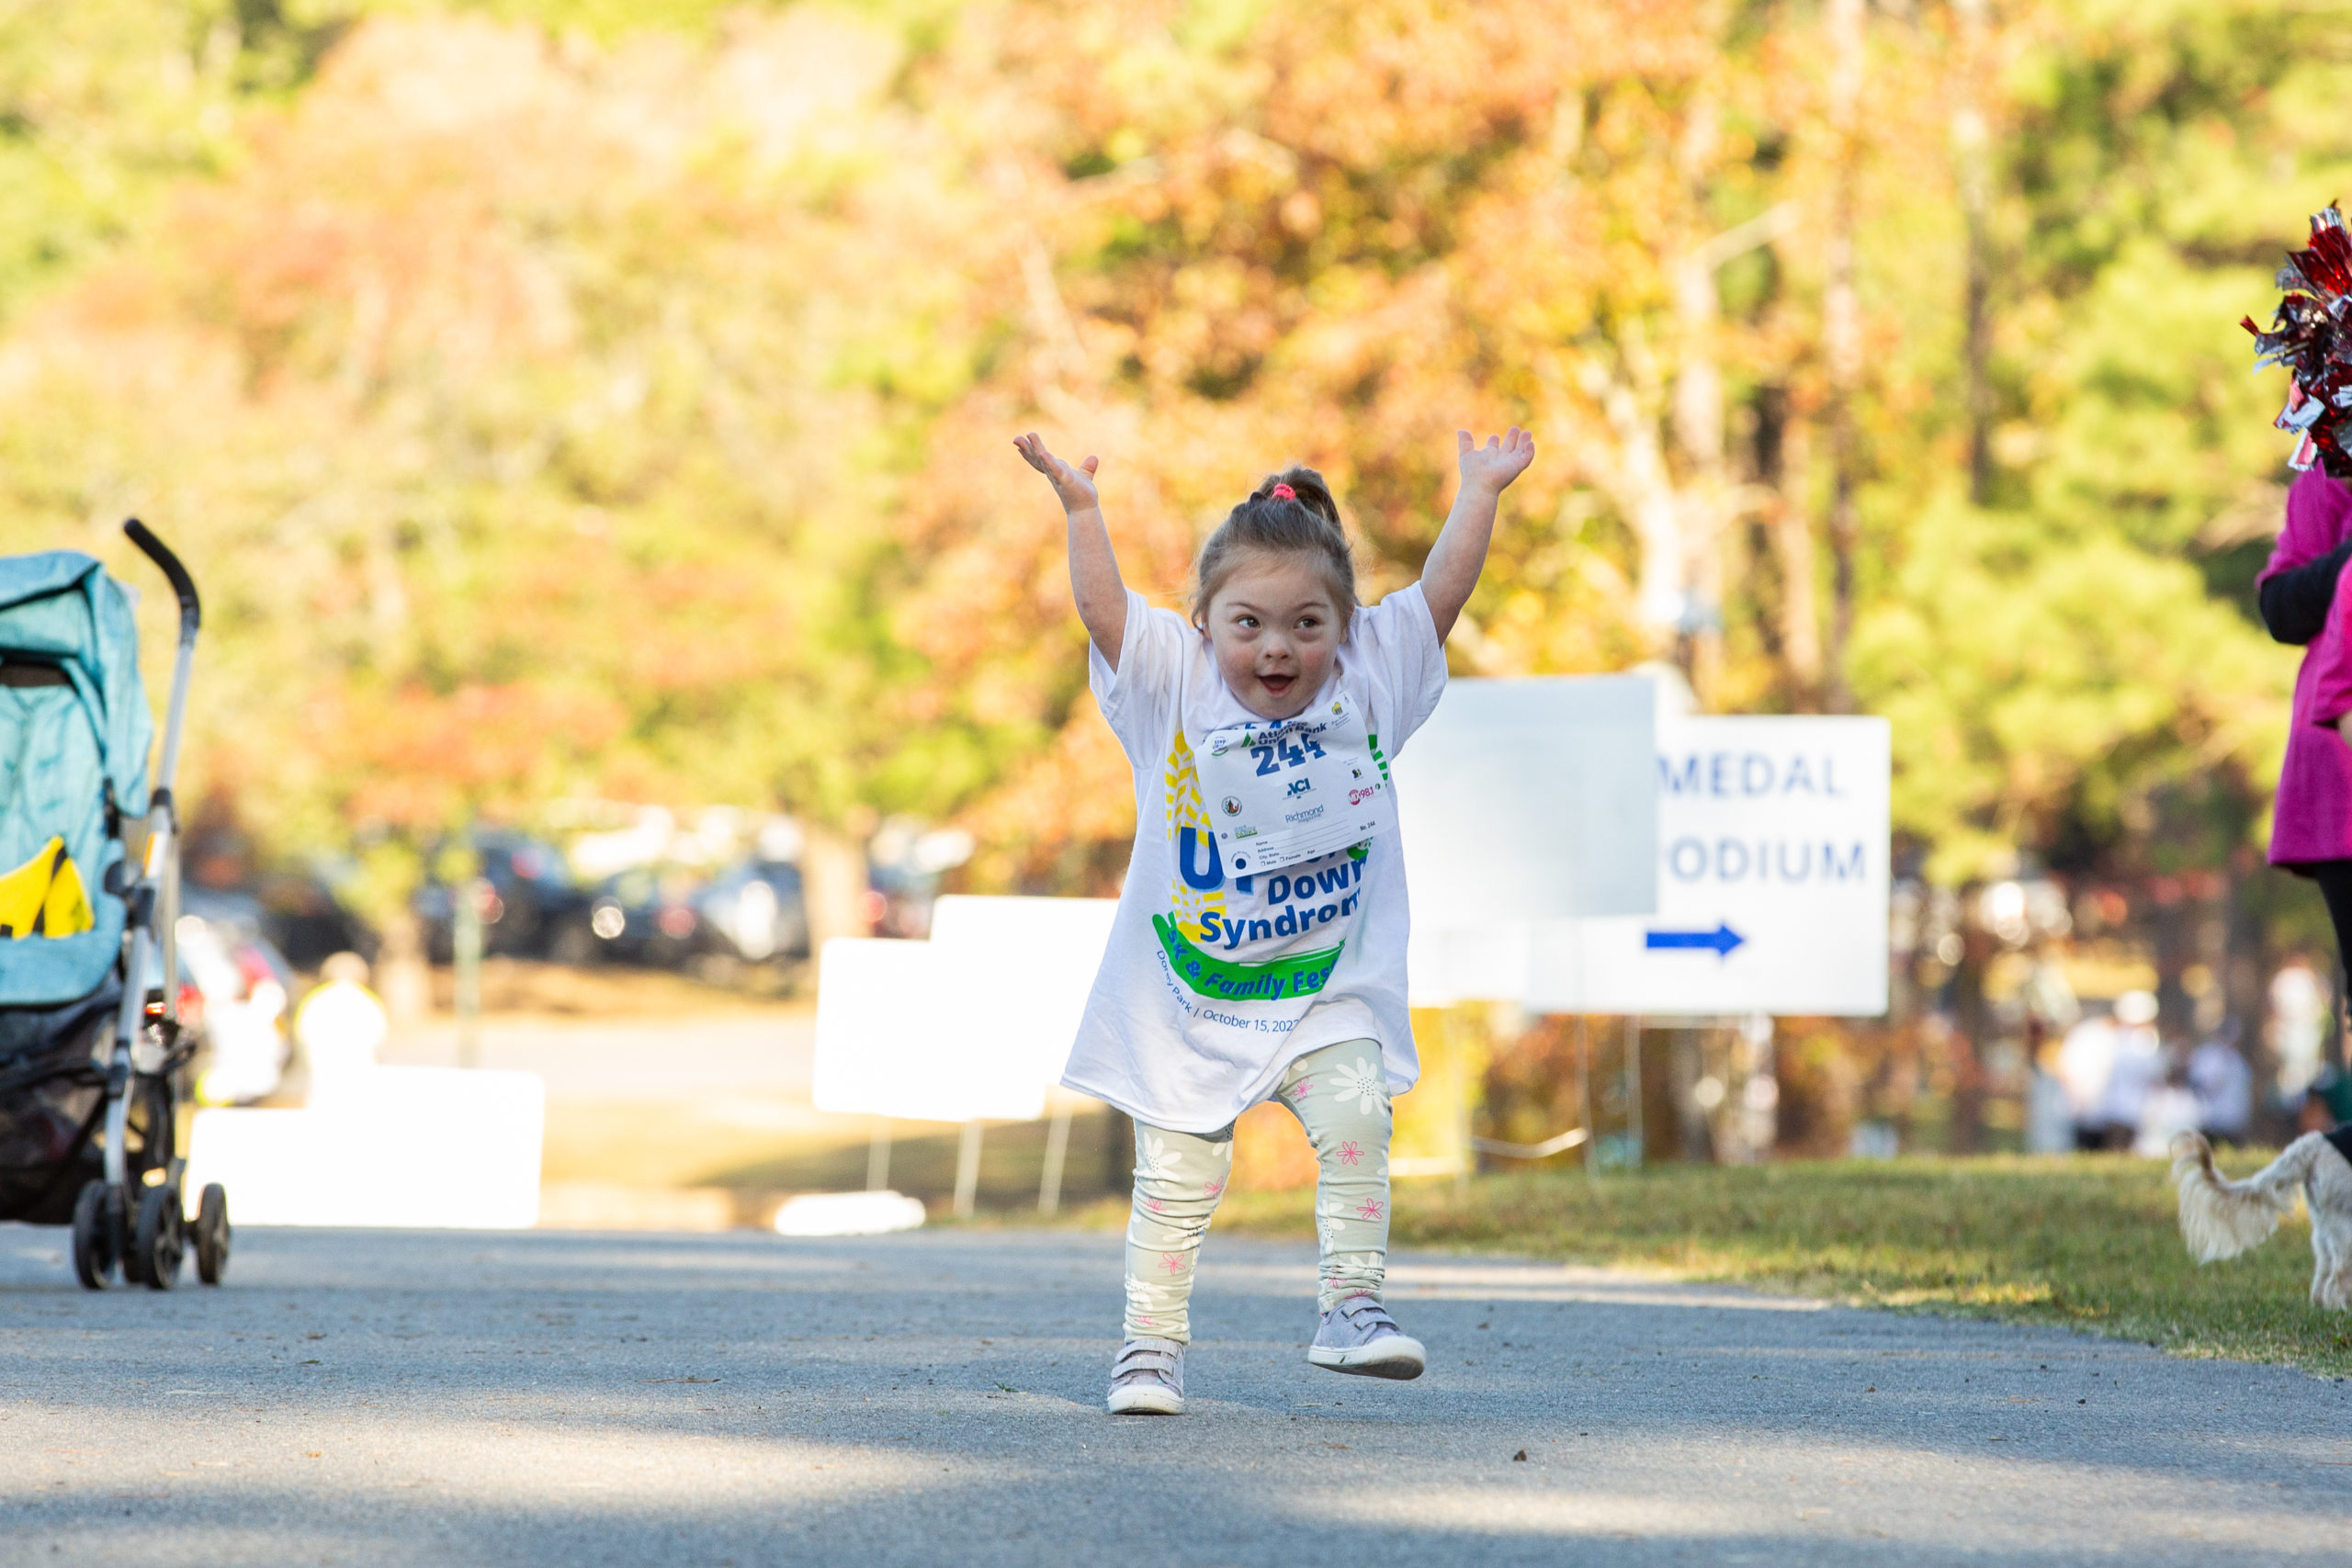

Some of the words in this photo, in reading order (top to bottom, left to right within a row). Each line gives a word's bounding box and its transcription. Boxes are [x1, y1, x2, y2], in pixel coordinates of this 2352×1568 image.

[1250, 732, 1327, 777] 244
[1657, 752, 1846, 796] MEDAL
[1285, 803, 1324, 823] Richmond
[1180, 826, 1254, 896] U
[1665, 836, 1866, 884] ODIUM
[1167, 930, 1189, 960] 5K
[1185, 960, 1203, 979] &
[1204, 973, 1287, 1001] Family
[1156, 950, 1173, 987] Dorey
[1172, 987, 1193, 1013] Park
[1203, 1010, 1251, 1030] October
[1254, 1020, 1270, 1032] 15,
